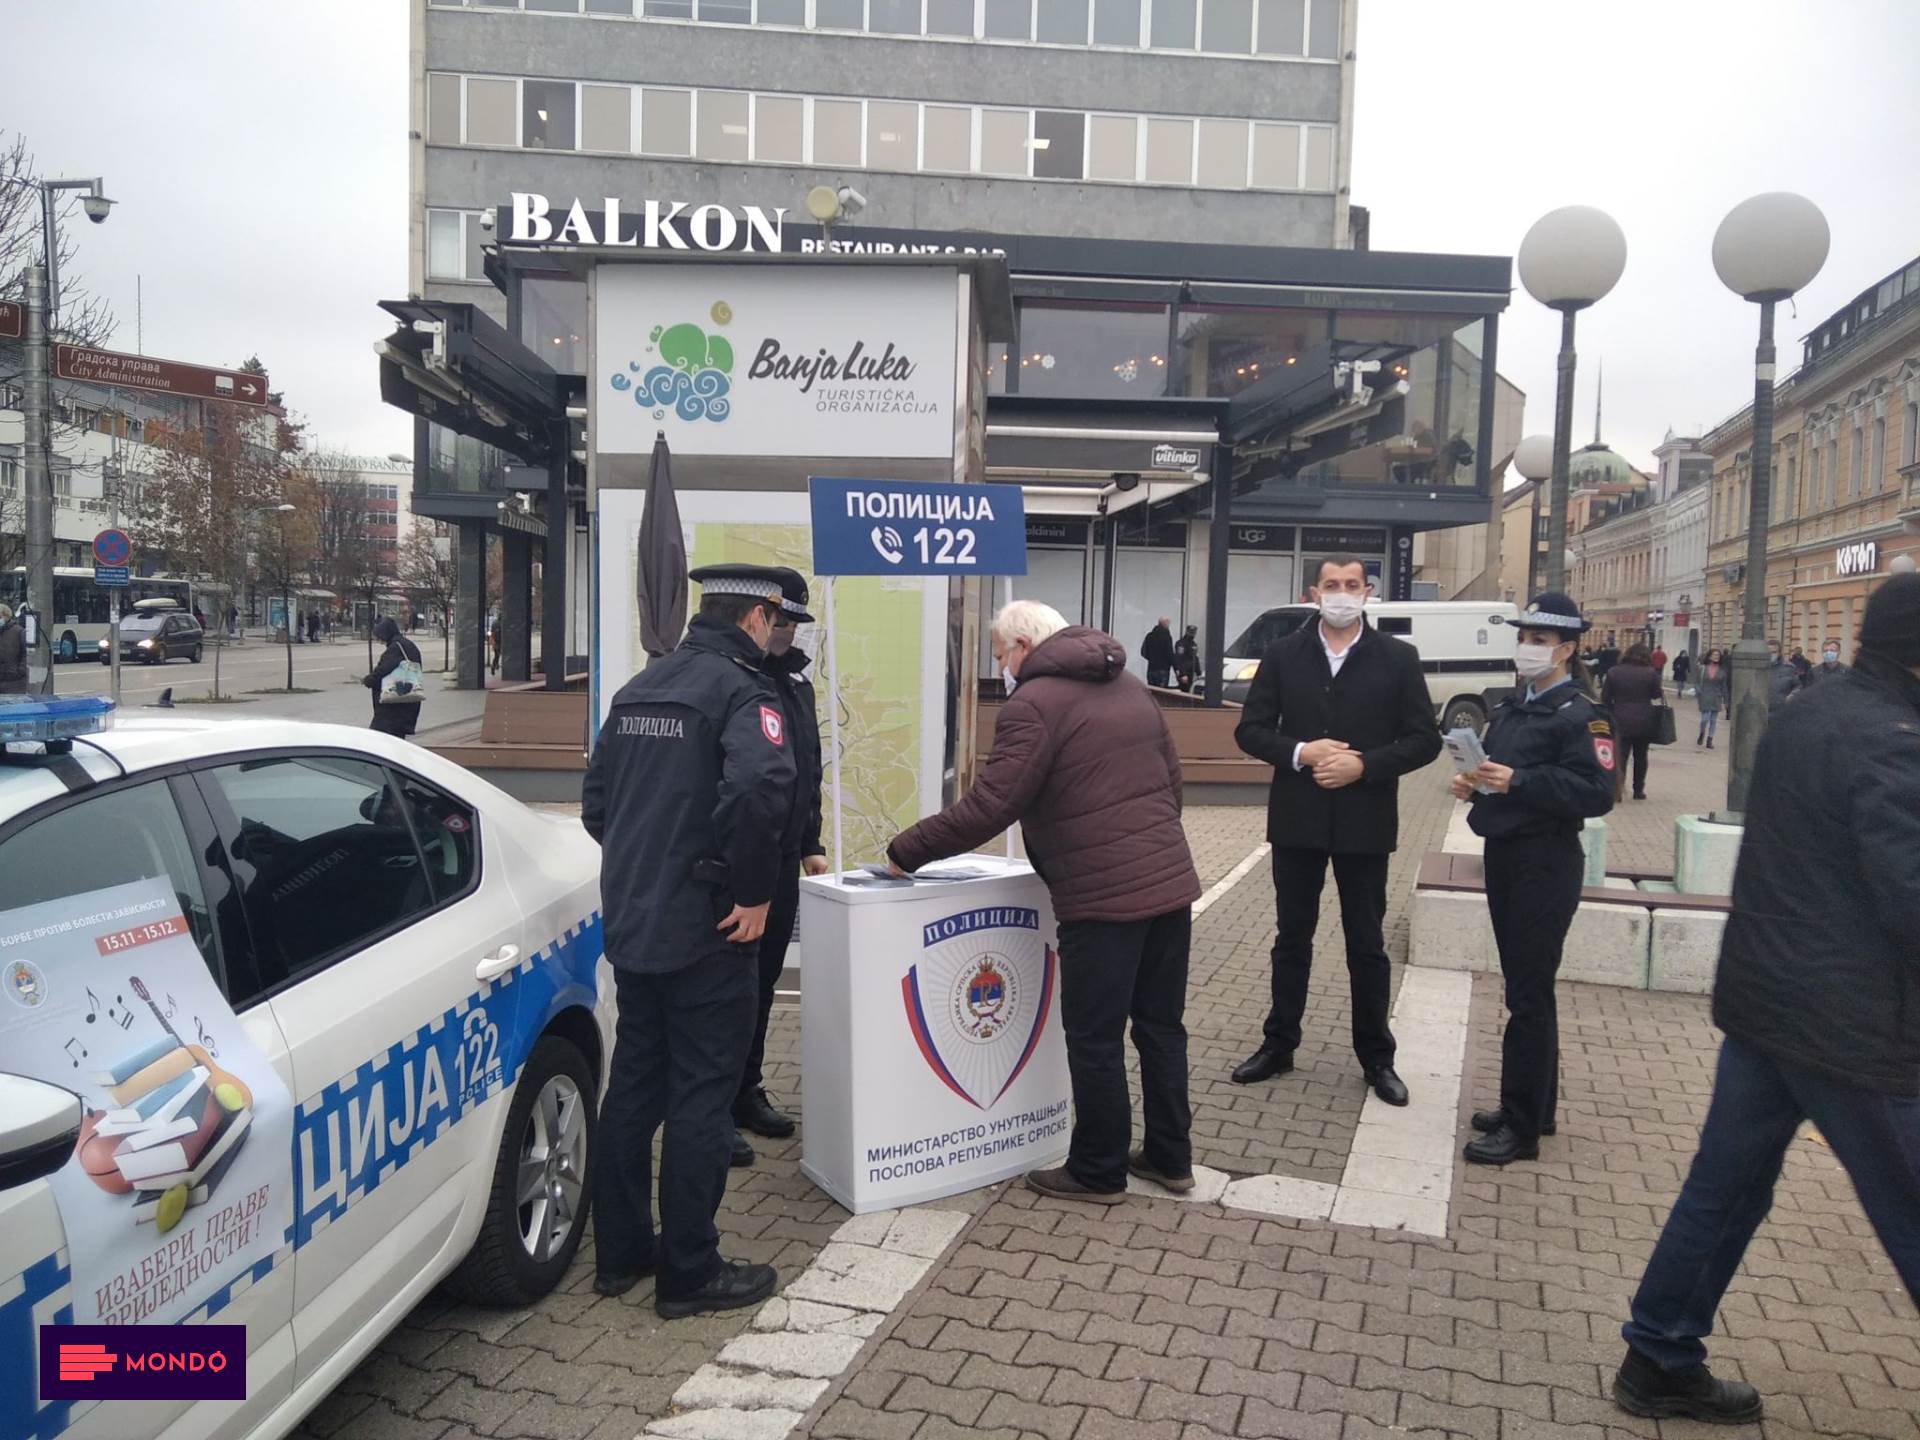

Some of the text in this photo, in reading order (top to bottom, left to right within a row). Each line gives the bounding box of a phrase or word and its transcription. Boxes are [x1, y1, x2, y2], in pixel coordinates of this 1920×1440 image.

[509, 191, 789, 253] BALKON
[70, 349, 160, 374] Градска управа
[70, 363, 171, 388] City Administration
[816, 401, 938, 414] ORGANIZACIJA
[817, 388, 915, 402] TURISTIČKA
[846, 491, 995, 524] ПОЛИЦИЈА
[913, 527, 977, 564] 122
[1237, 529, 1267, 543] UGG
[616, 716, 684, 739] ПОЛИЦИЈА
[0, 898, 167, 947] БОРБЕ ПРОТИВ БОЛЕСТИ ЗАВИСНОСТИ
[925, 908, 1037, 943] ПОЛИЦИЈА
[103, 932, 137, 950] 15.11
[454, 1022, 502, 1093] 122
[458, 1066, 503, 1107] POLICE
[867, 1100, 1068, 1163] МИНИСТАРСТВО УНУТРАШЊИХ
[869, 1117, 1067, 1183] ПОСЛОВА РЕПУБЛИКЕ СРПСКЕ
[95, 1184, 270, 1318] ИЗАБЕРИ ПРАВЕ
